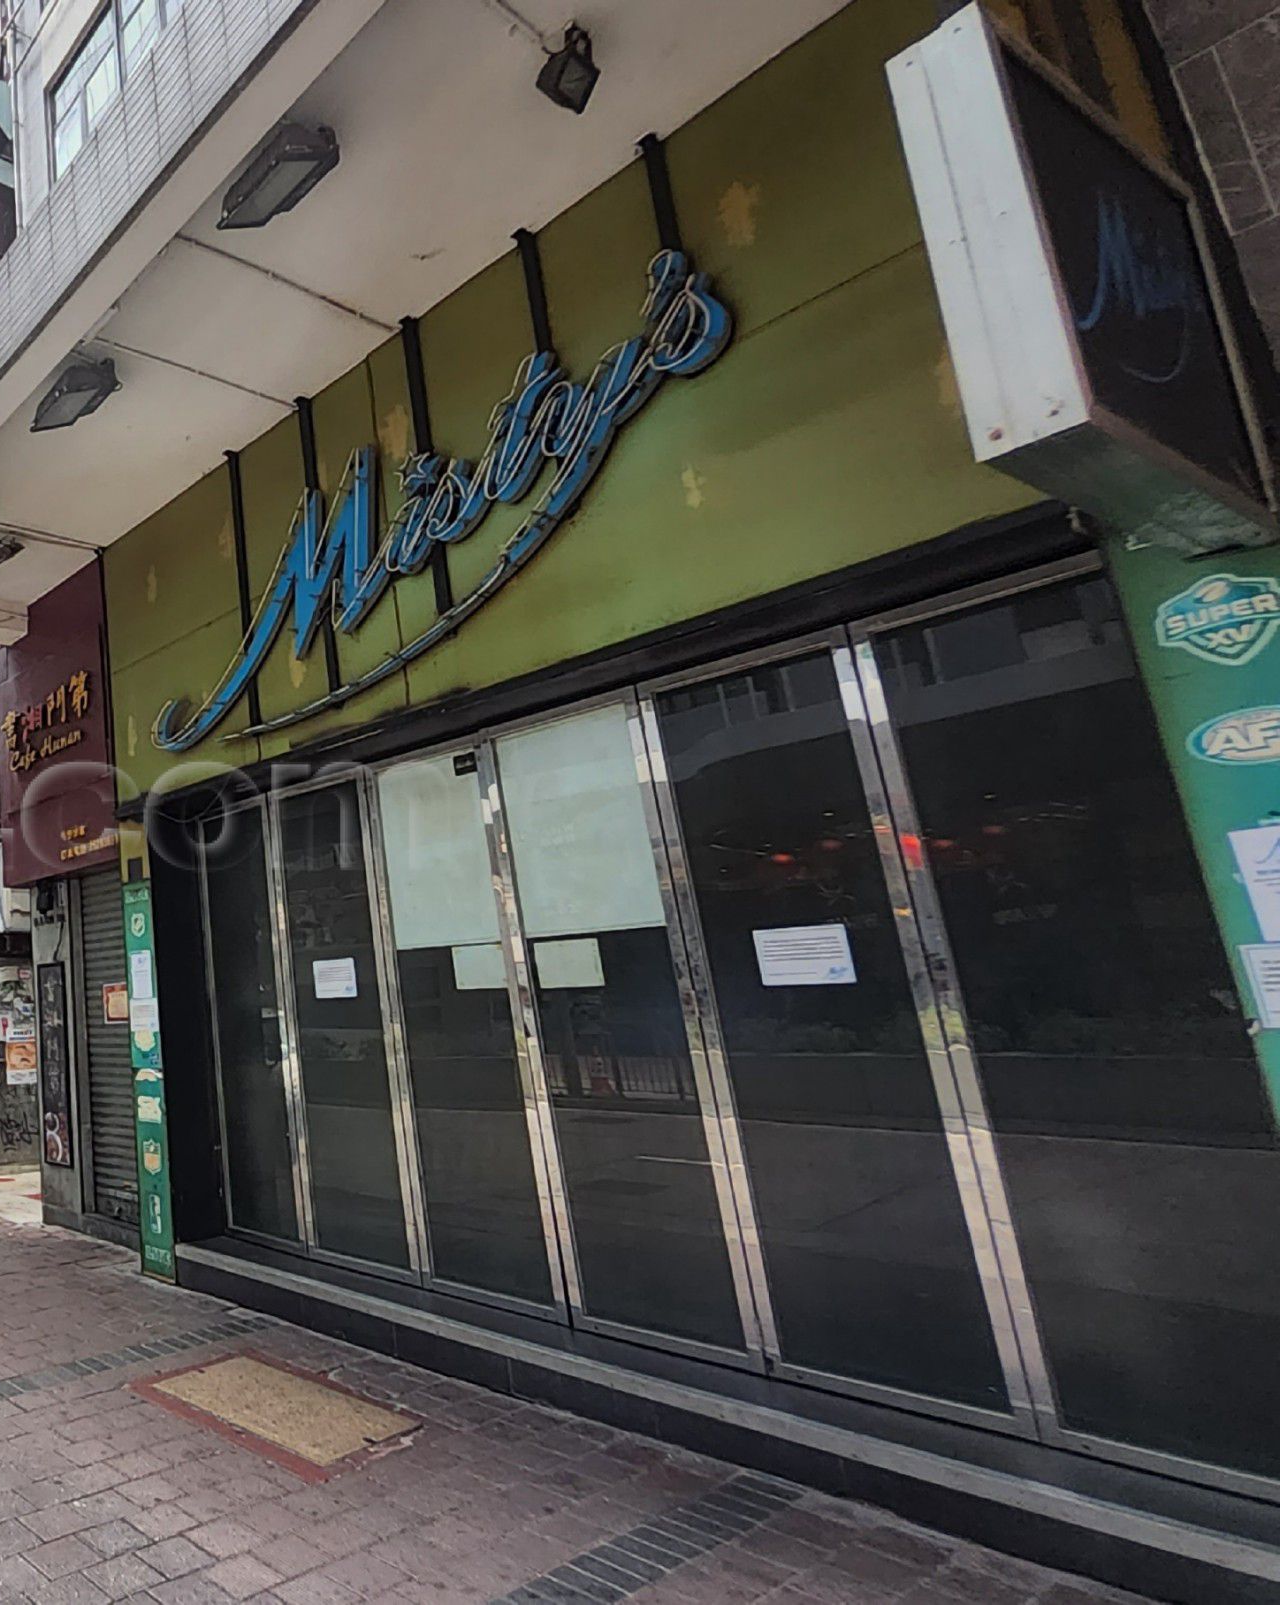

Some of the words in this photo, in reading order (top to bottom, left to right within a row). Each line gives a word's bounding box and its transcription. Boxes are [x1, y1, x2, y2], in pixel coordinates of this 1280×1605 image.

[152, 248, 734, 752] Misty's
[1166, 593, 1279, 635] SUPER
[1203, 624, 1257, 650] XV
[40, 729, 81, 758] Hunan
